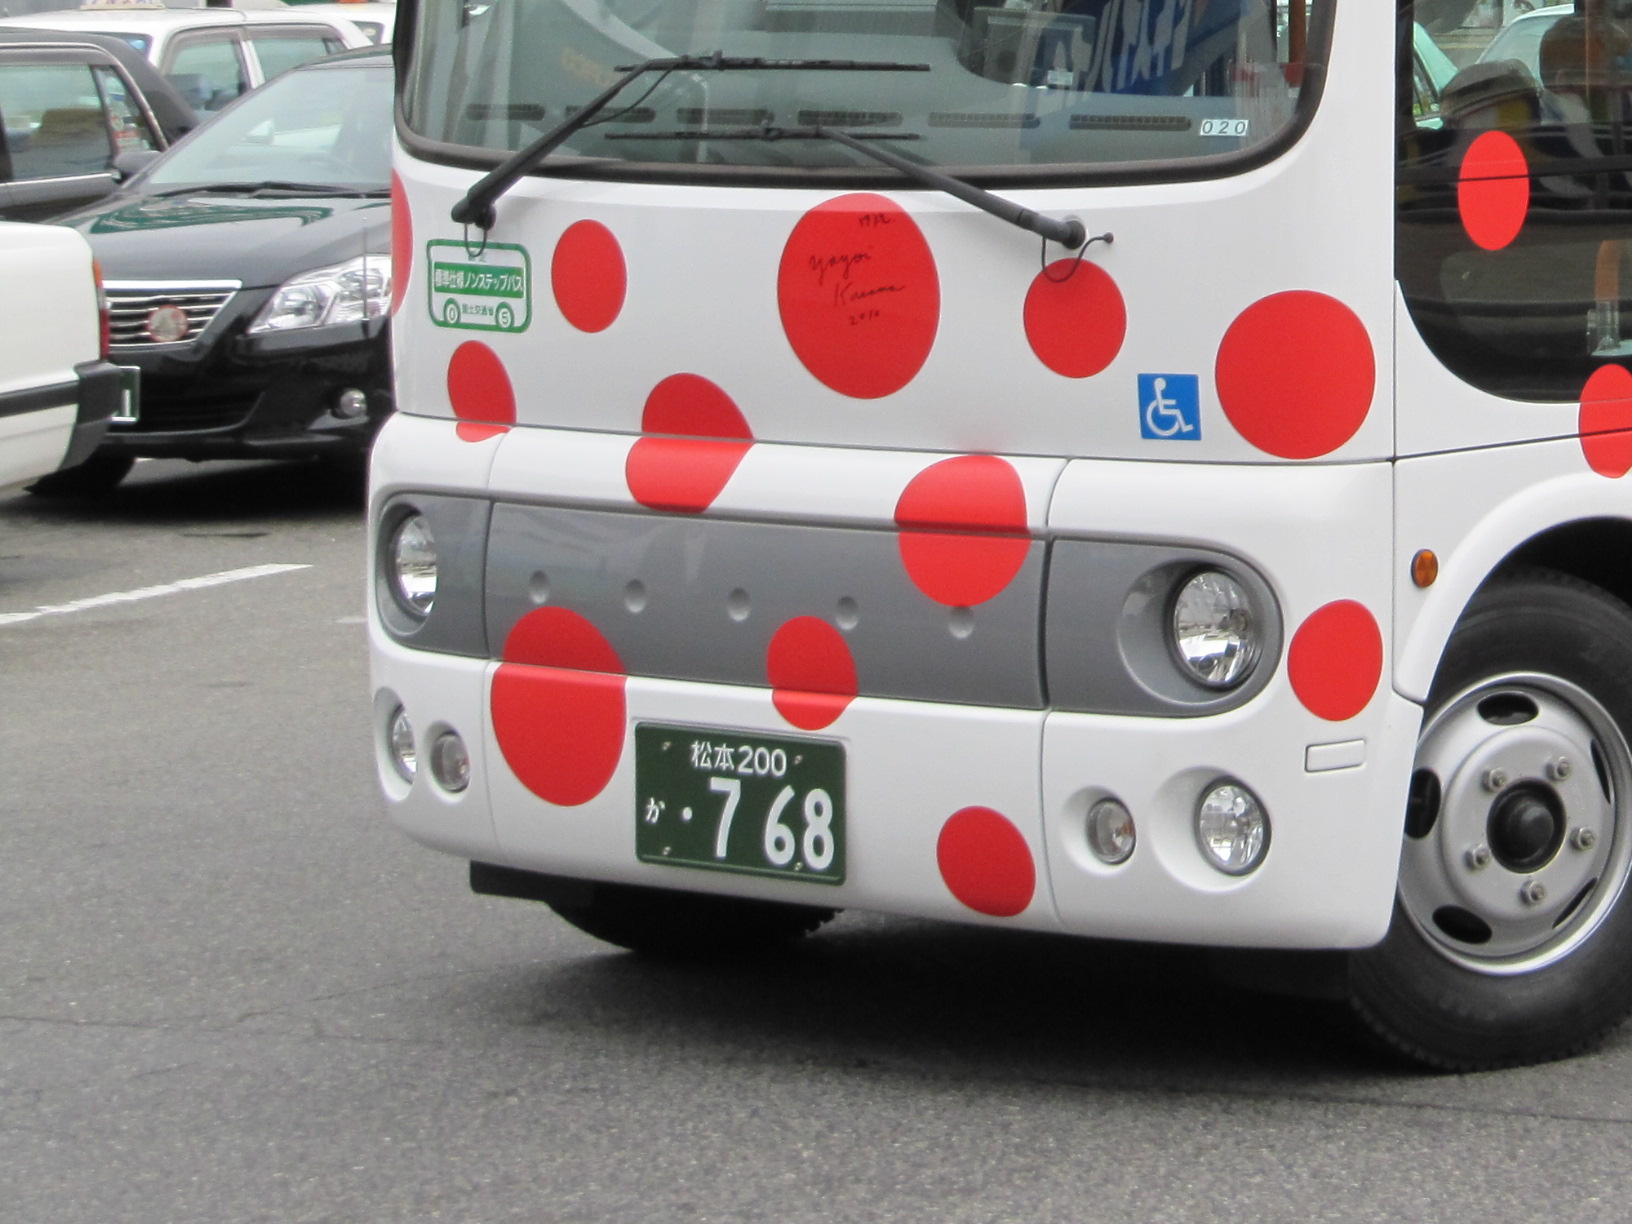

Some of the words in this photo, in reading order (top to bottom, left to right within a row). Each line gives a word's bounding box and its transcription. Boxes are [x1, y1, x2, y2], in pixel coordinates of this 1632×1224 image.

[1203, 121, 1246, 134] 020
[691, 739, 788, 777] 松本200
[645, 796, 666, 824] か
